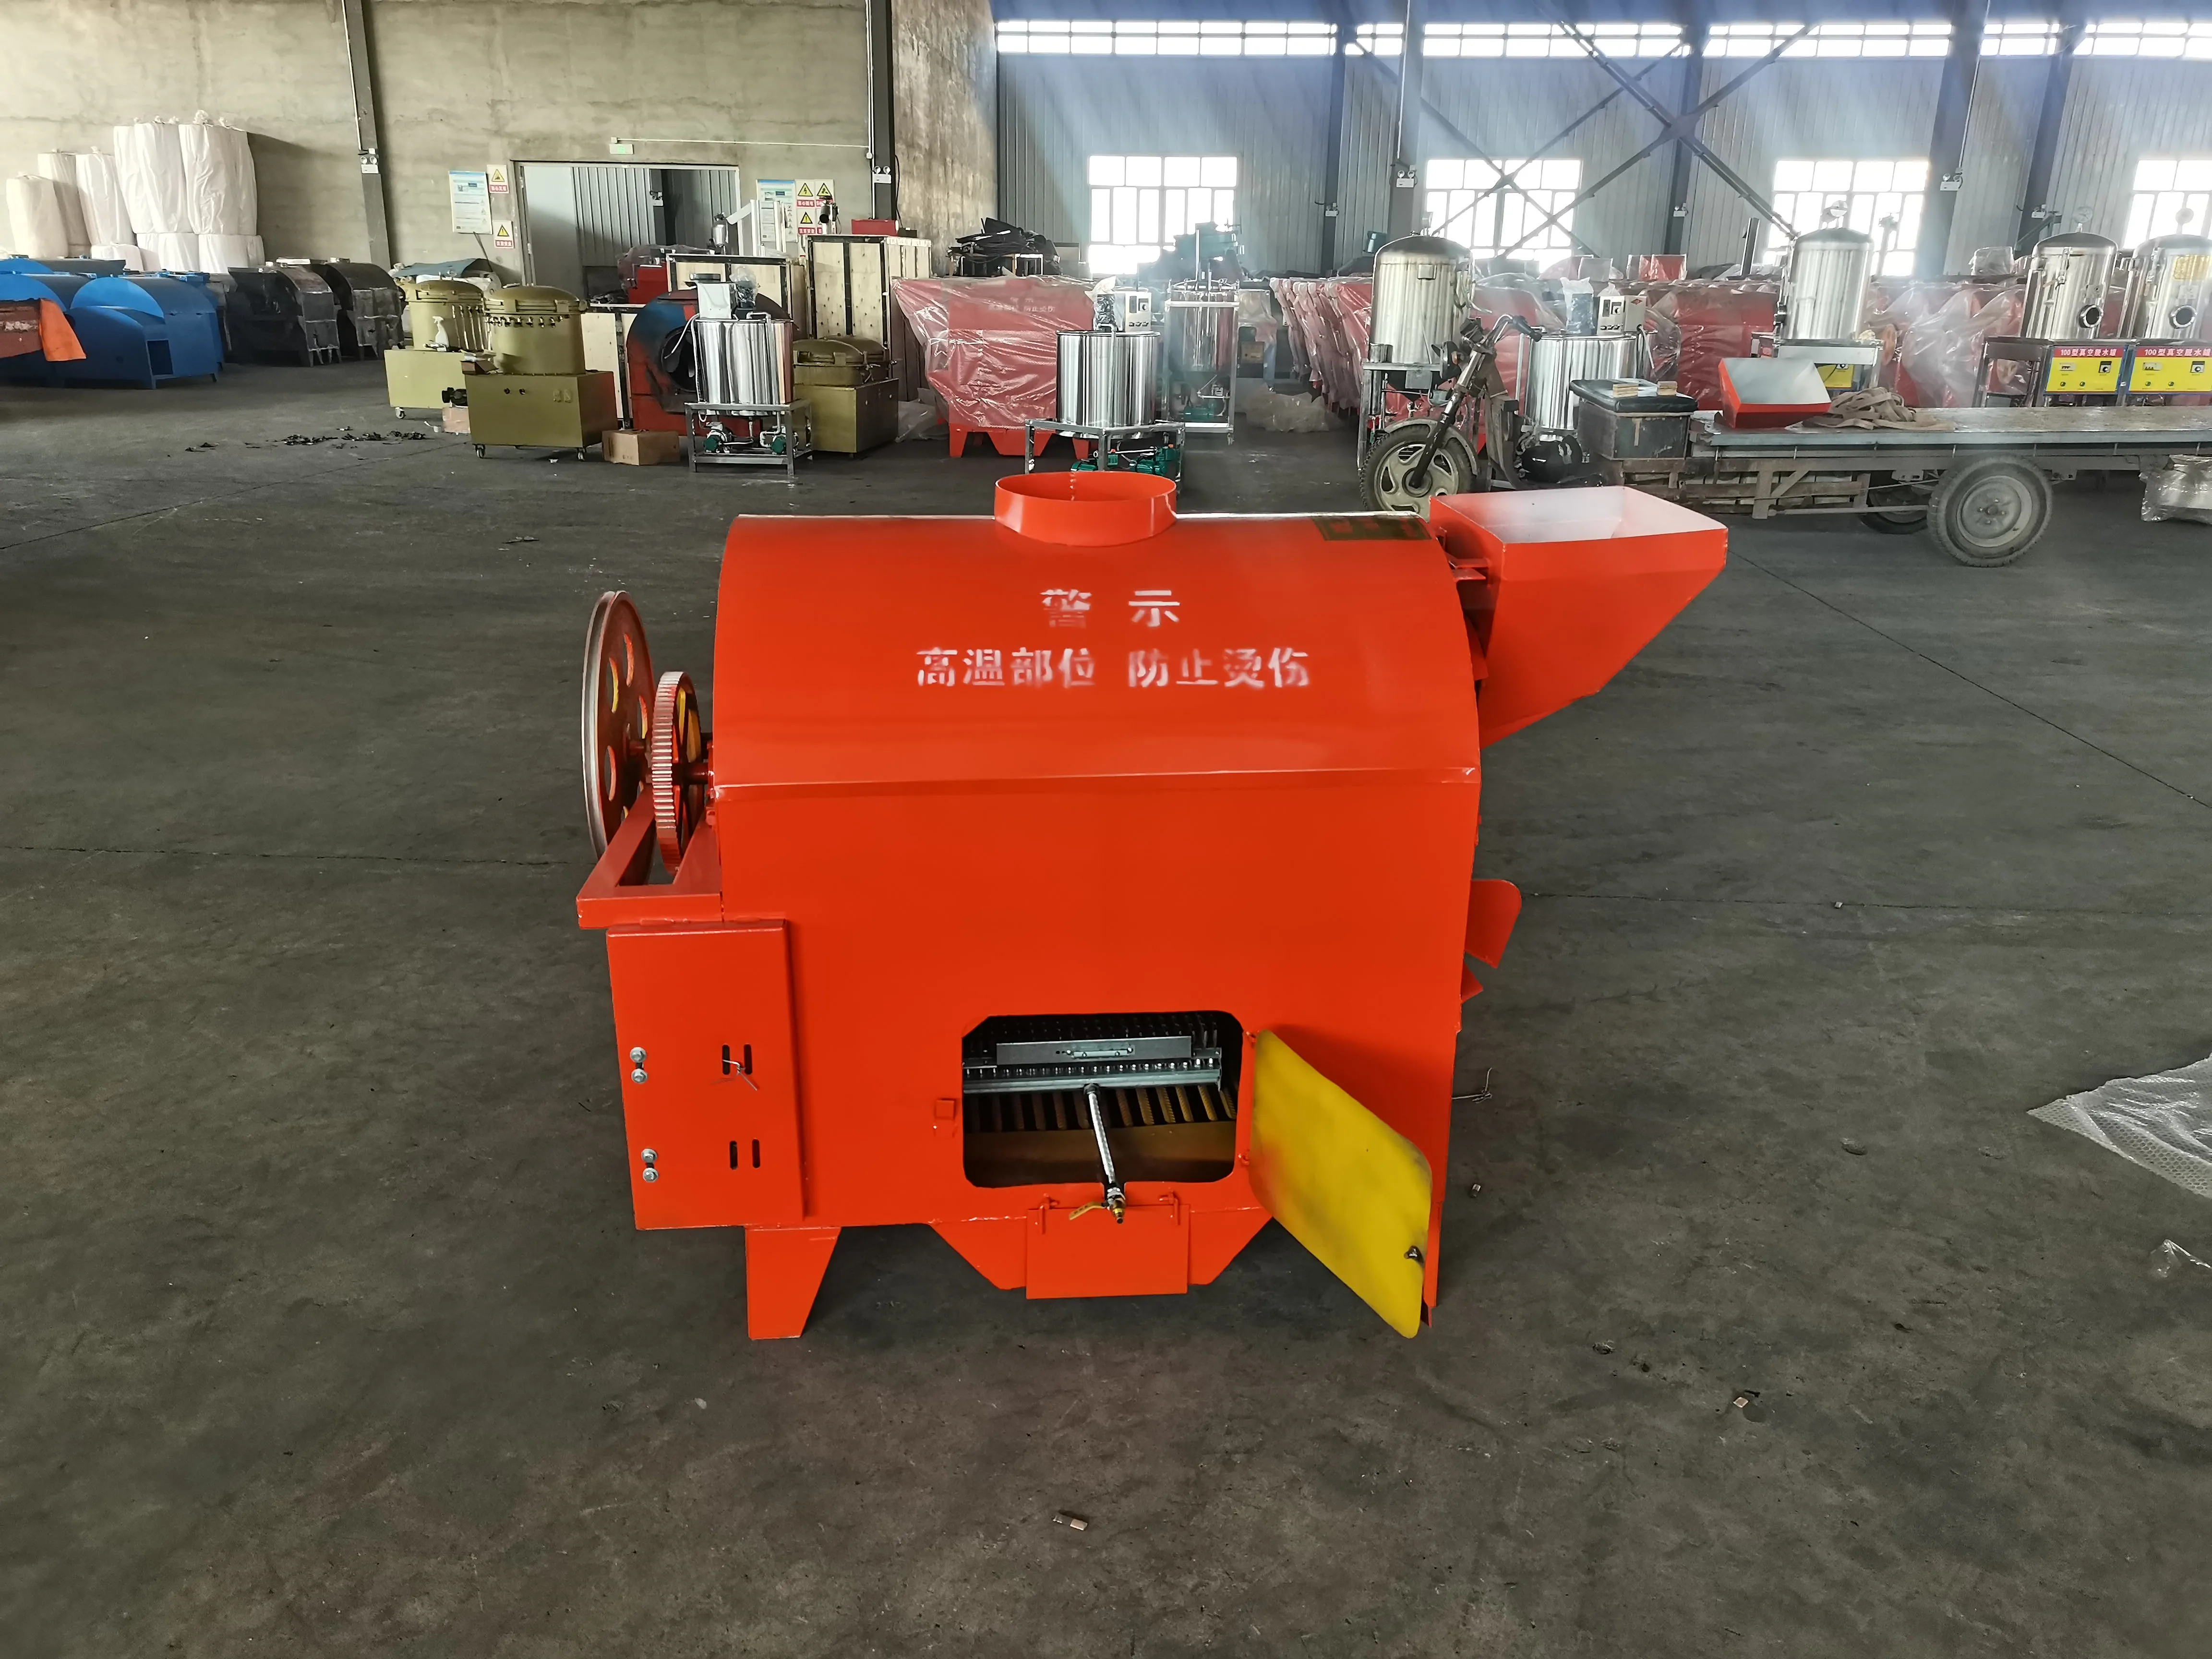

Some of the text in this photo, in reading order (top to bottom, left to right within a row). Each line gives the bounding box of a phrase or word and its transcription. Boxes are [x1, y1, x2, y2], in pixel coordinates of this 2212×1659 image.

[916, 646, 1310, 688] 高温部位 防止烫伤
